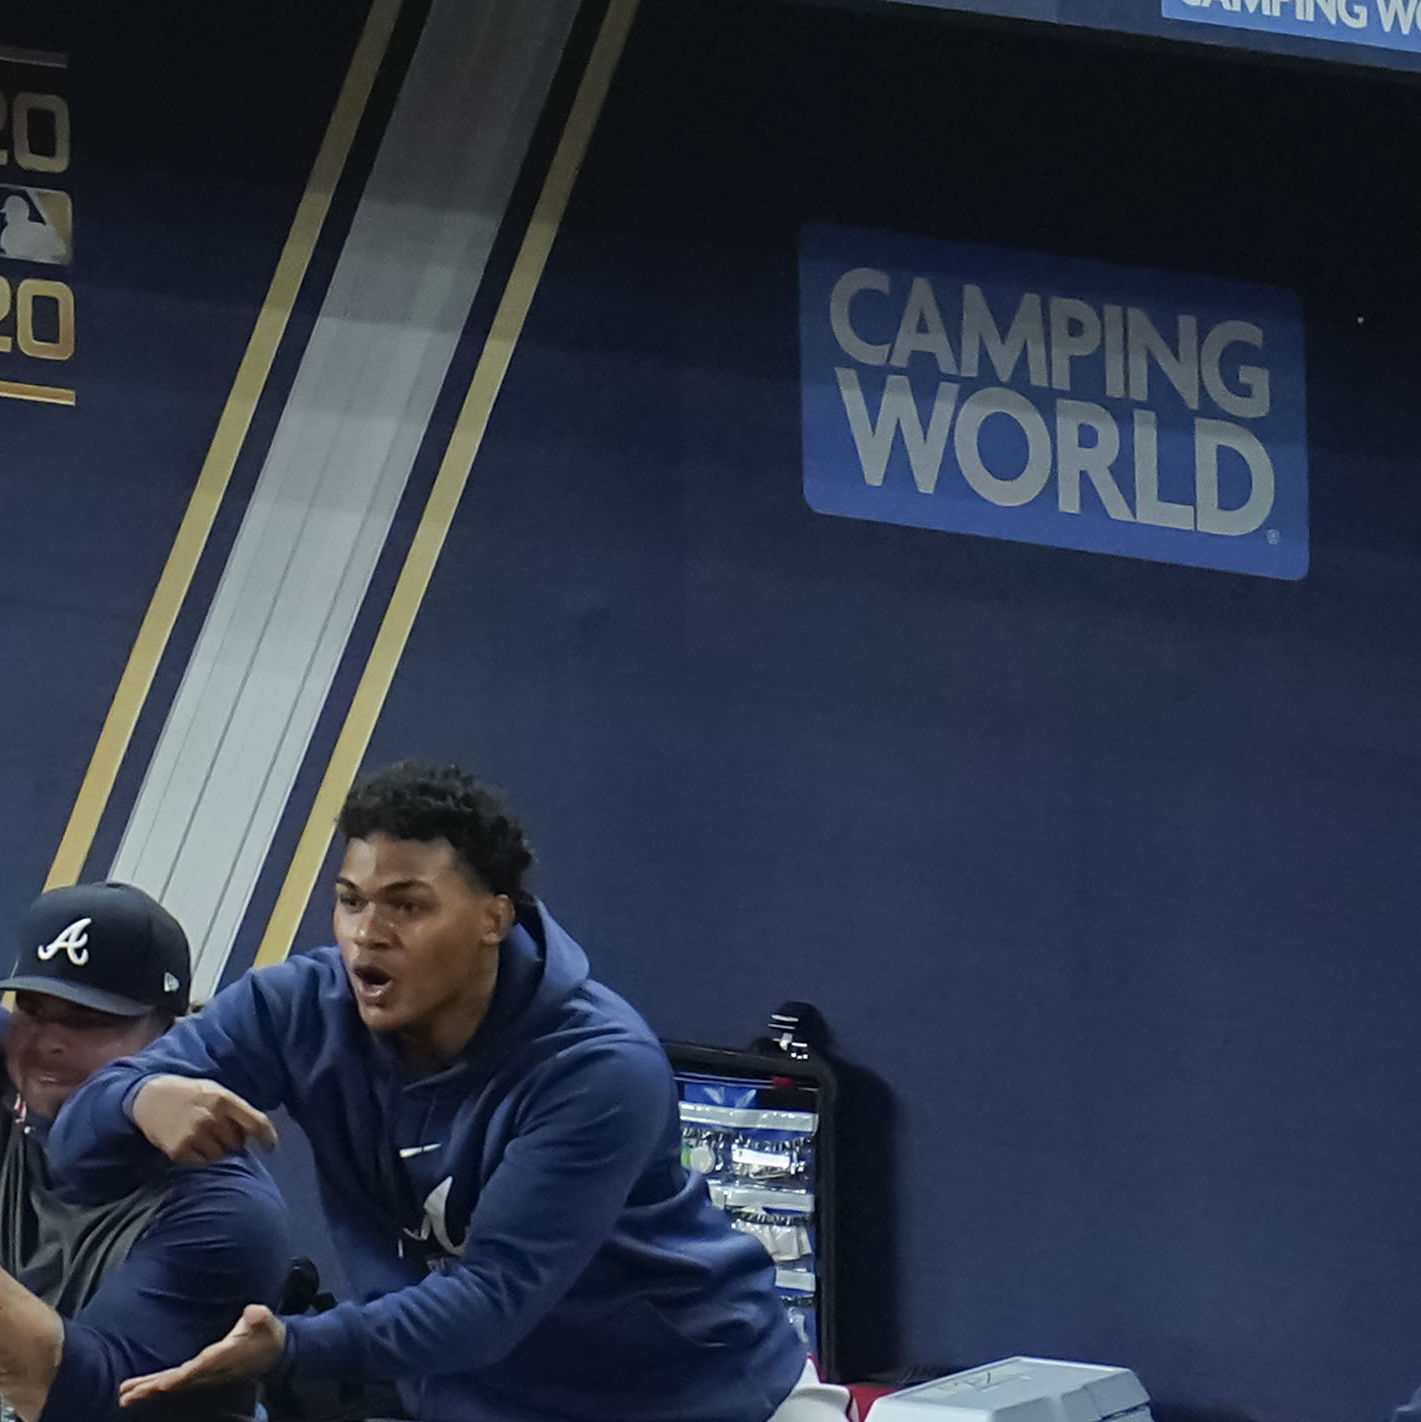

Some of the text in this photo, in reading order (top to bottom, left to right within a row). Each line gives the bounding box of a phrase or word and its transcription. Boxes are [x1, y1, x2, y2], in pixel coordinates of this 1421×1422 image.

[830, 267, 1271, 419] CAMPING
[836, 368, 1276, 537] WORLD
[38, 918, 92, 966] A
